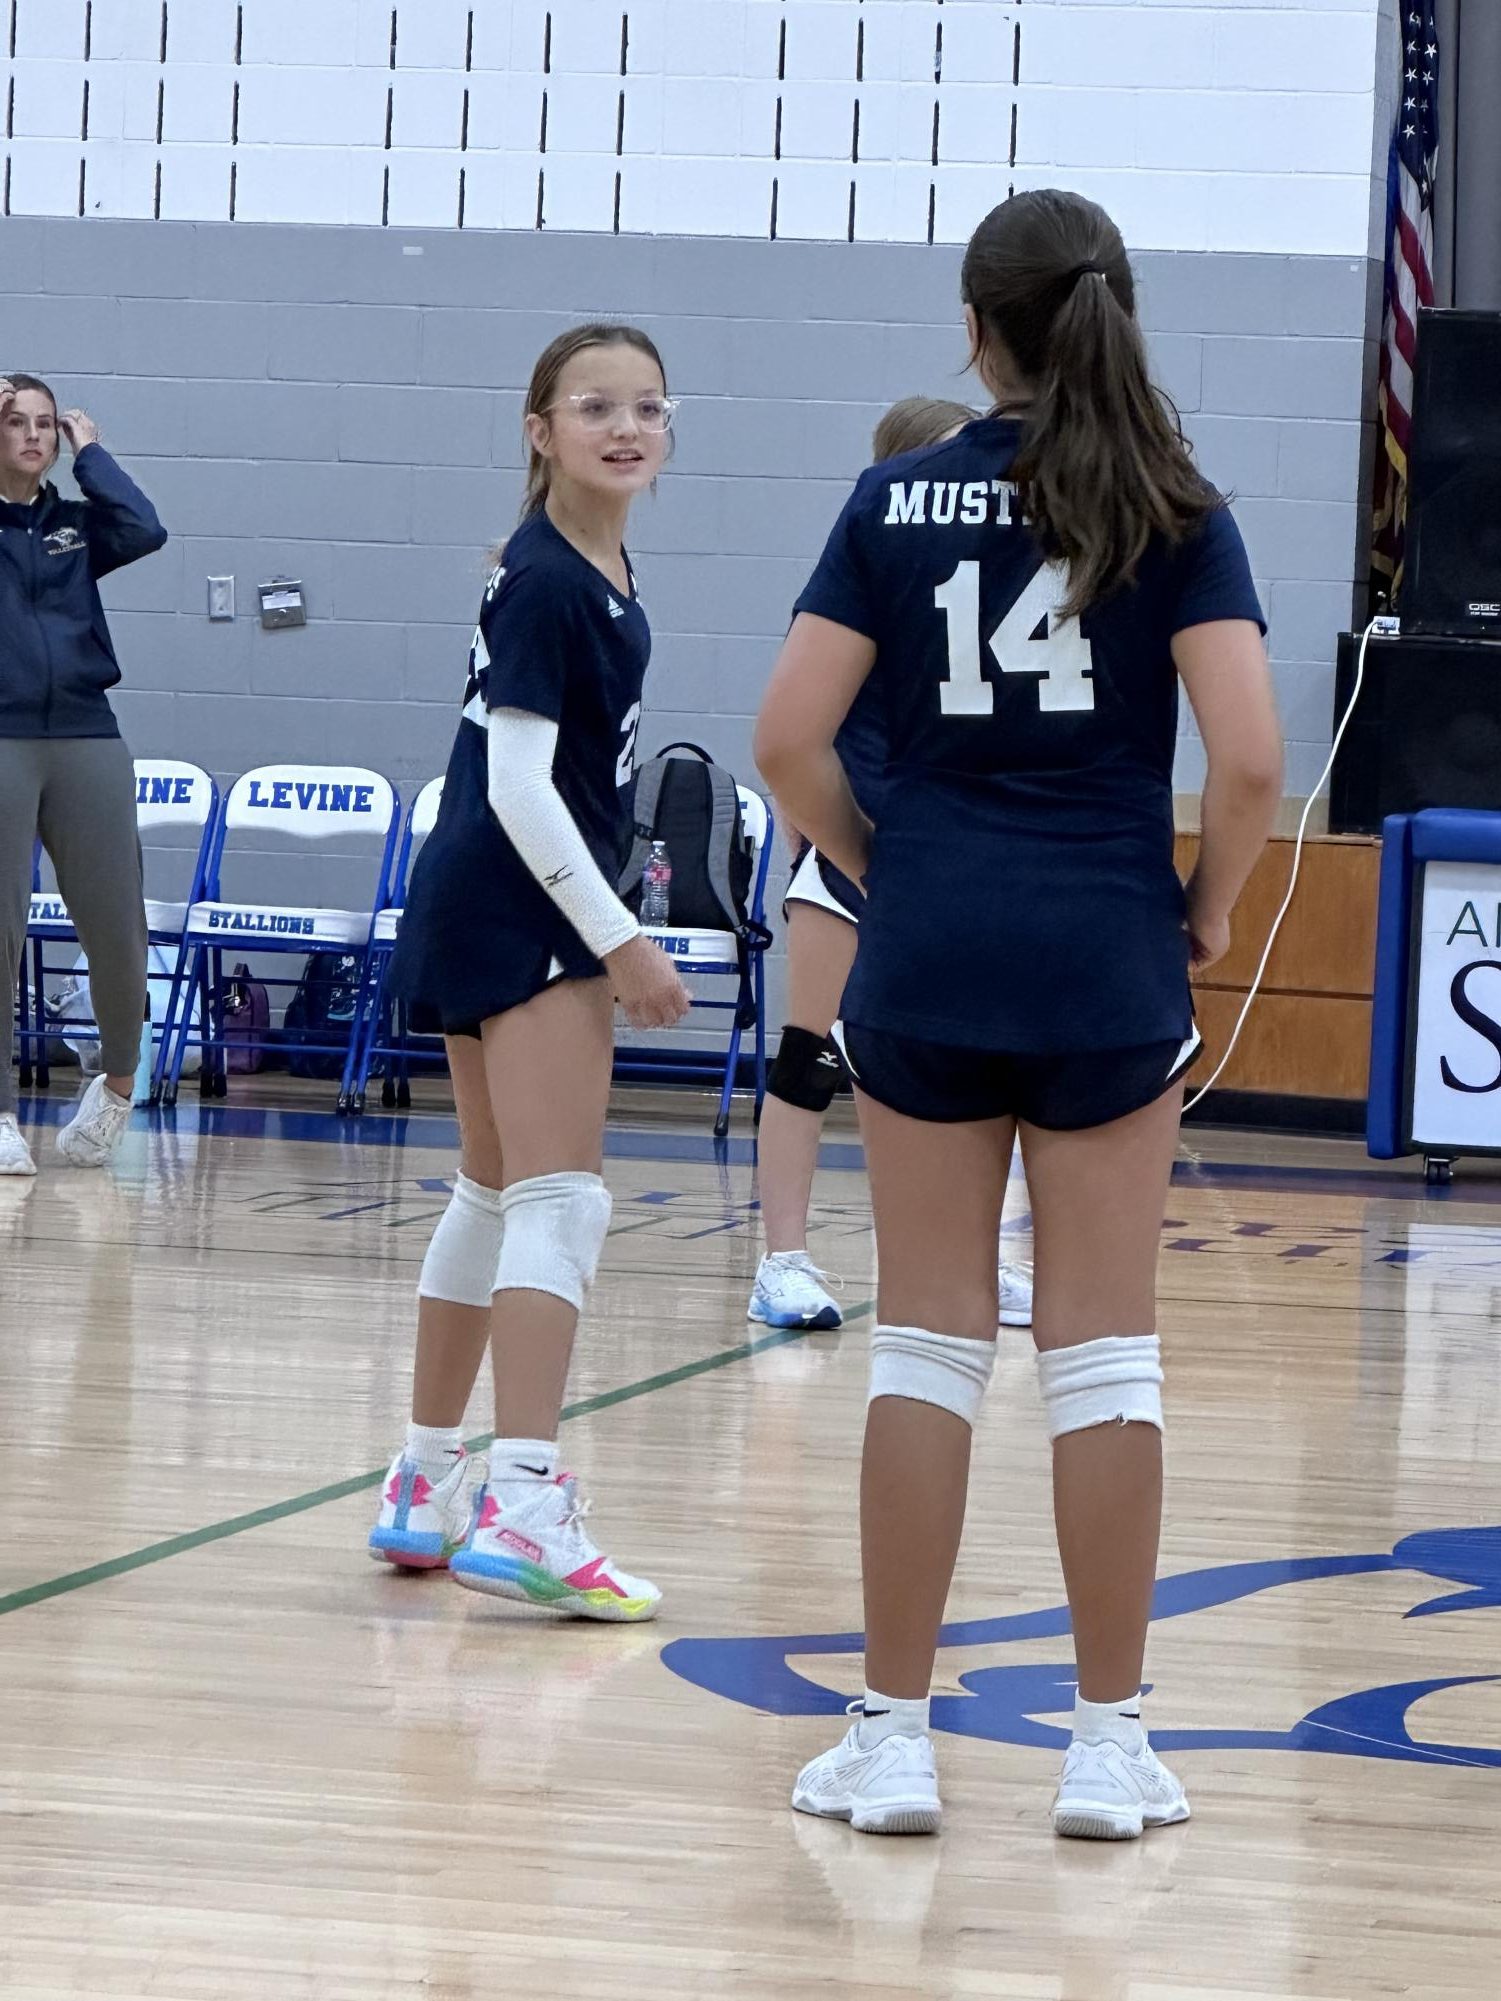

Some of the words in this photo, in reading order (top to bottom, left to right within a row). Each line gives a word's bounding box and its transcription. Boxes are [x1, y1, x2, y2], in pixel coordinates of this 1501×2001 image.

[934, 556, 1095, 715] 14
[135, 777, 194, 804] INE
[247, 781, 374, 813] LEVINE
[208, 910, 315, 935] STALLIONS
[1446, 900, 1501, 948] A
